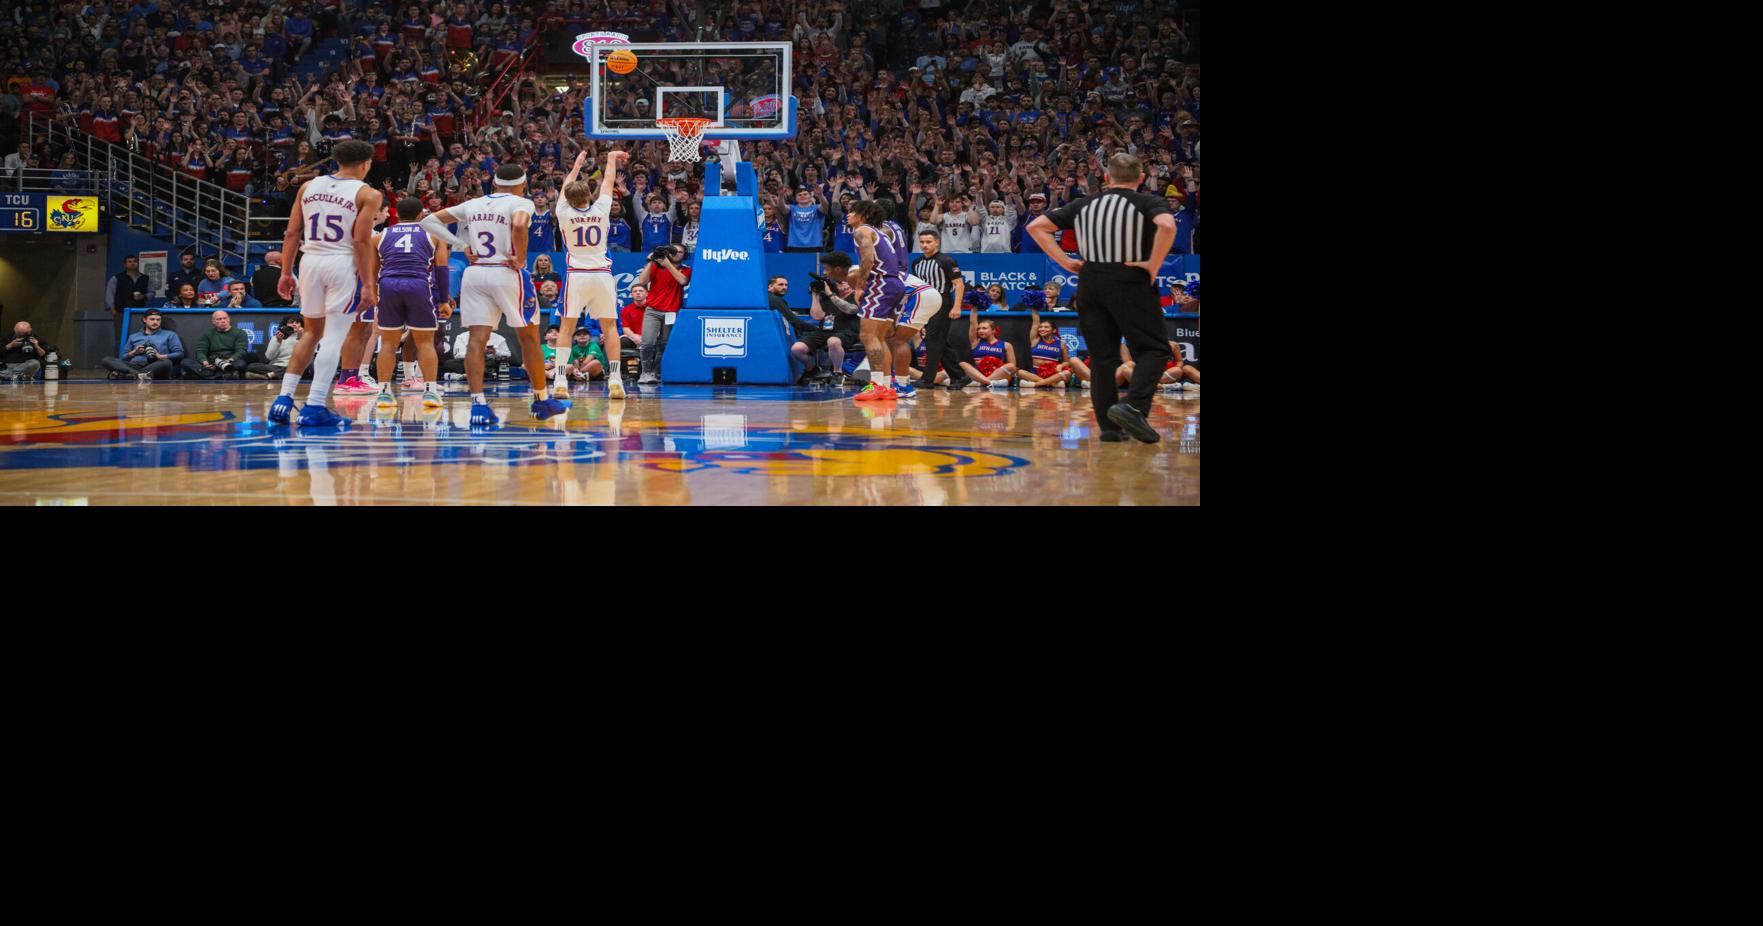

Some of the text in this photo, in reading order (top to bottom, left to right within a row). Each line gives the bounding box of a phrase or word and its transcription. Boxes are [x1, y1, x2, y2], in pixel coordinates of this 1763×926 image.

[6, 194, 30, 205] TCU
[303, 193, 356, 212] McCULLAR JR.
[14, 211, 33, 228] 16
[308, 212, 344, 242] 15
[533, 226, 543, 237] 4
[573, 225, 601, 247] 10
[653, 224, 658, 233] 1
[395, 233, 413, 253] 4
[477, 231, 496, 258] 3
[763, 233, 773, 242] 4
[980, 272, 1038, 281] BLACK &
